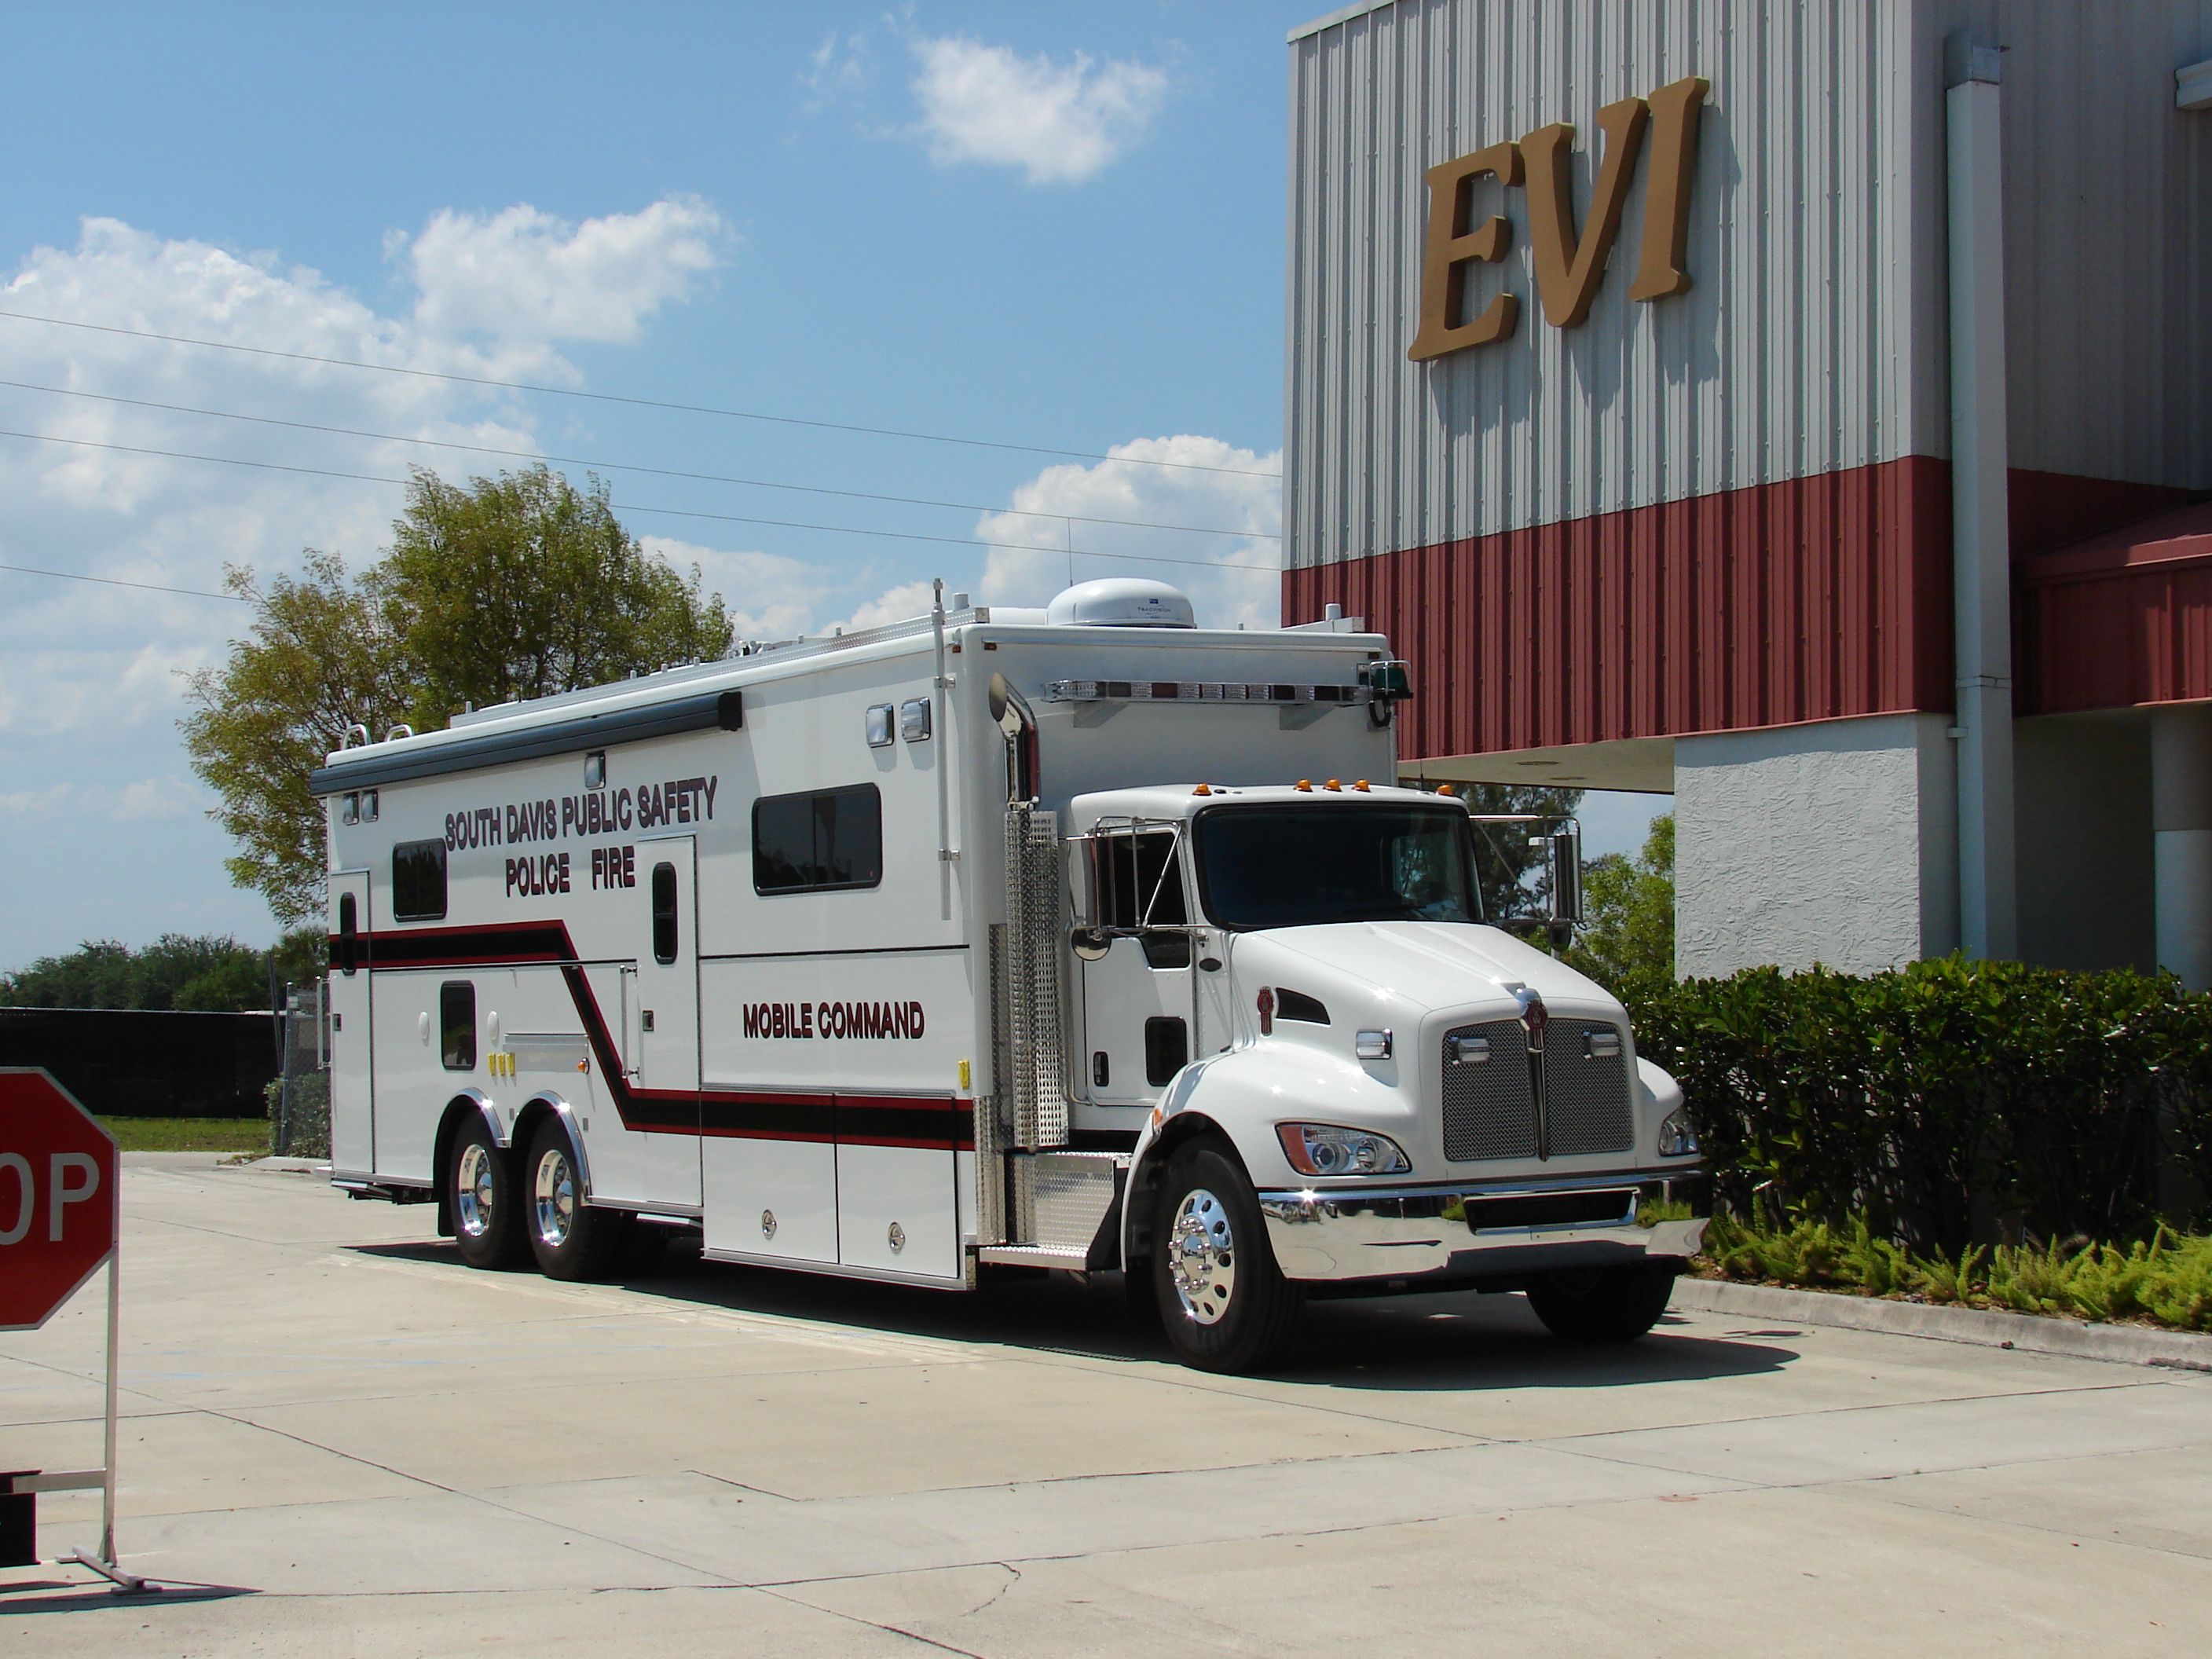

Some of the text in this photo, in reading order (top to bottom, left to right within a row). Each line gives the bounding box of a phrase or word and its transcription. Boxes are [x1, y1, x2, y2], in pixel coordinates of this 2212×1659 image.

[1408, 75, 1711, 363] EVI
[445, 775, 718, 851] SOUTH DAVIS PUBLIC SAFETY
[505, 845, 636, 898] POLICE FIRE
[743, 1001, 925, 1040] MOBILE COMMAND
